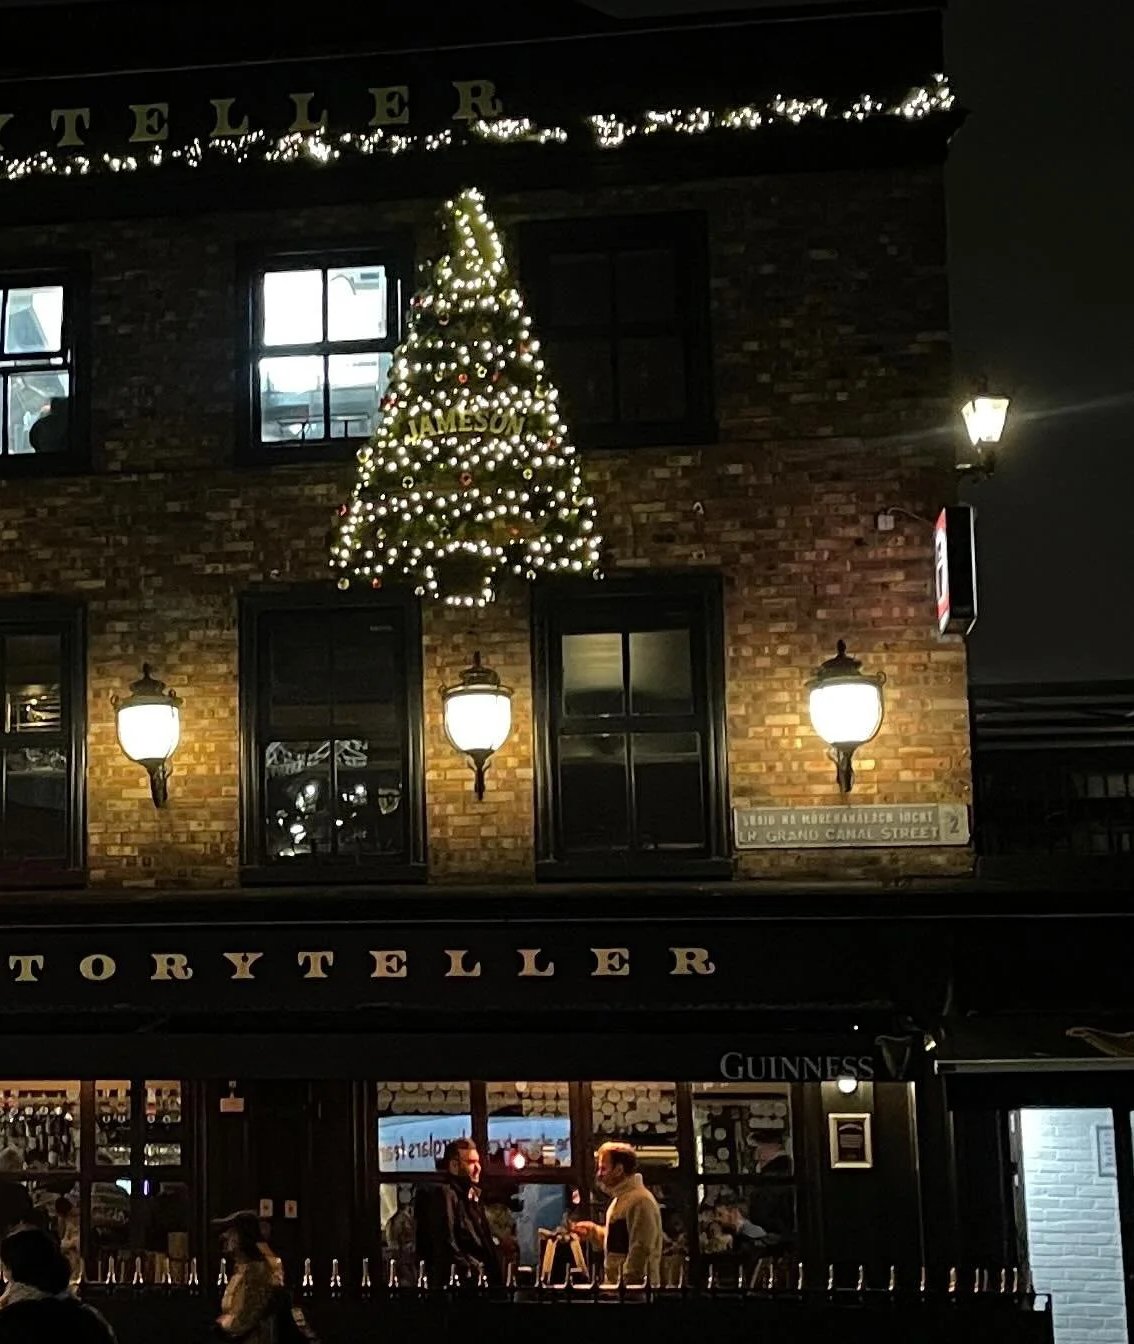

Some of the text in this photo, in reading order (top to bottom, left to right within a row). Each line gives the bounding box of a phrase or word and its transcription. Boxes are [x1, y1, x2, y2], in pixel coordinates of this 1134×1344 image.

[406, 408, 526, 443] JAMESON
[766, 828, 820, 843] GRAND
[825, 827, 875, 842] CANAL
[880, 826, 939, 841] STREET
[719, 1051, 875, 1081] GUINNESS
